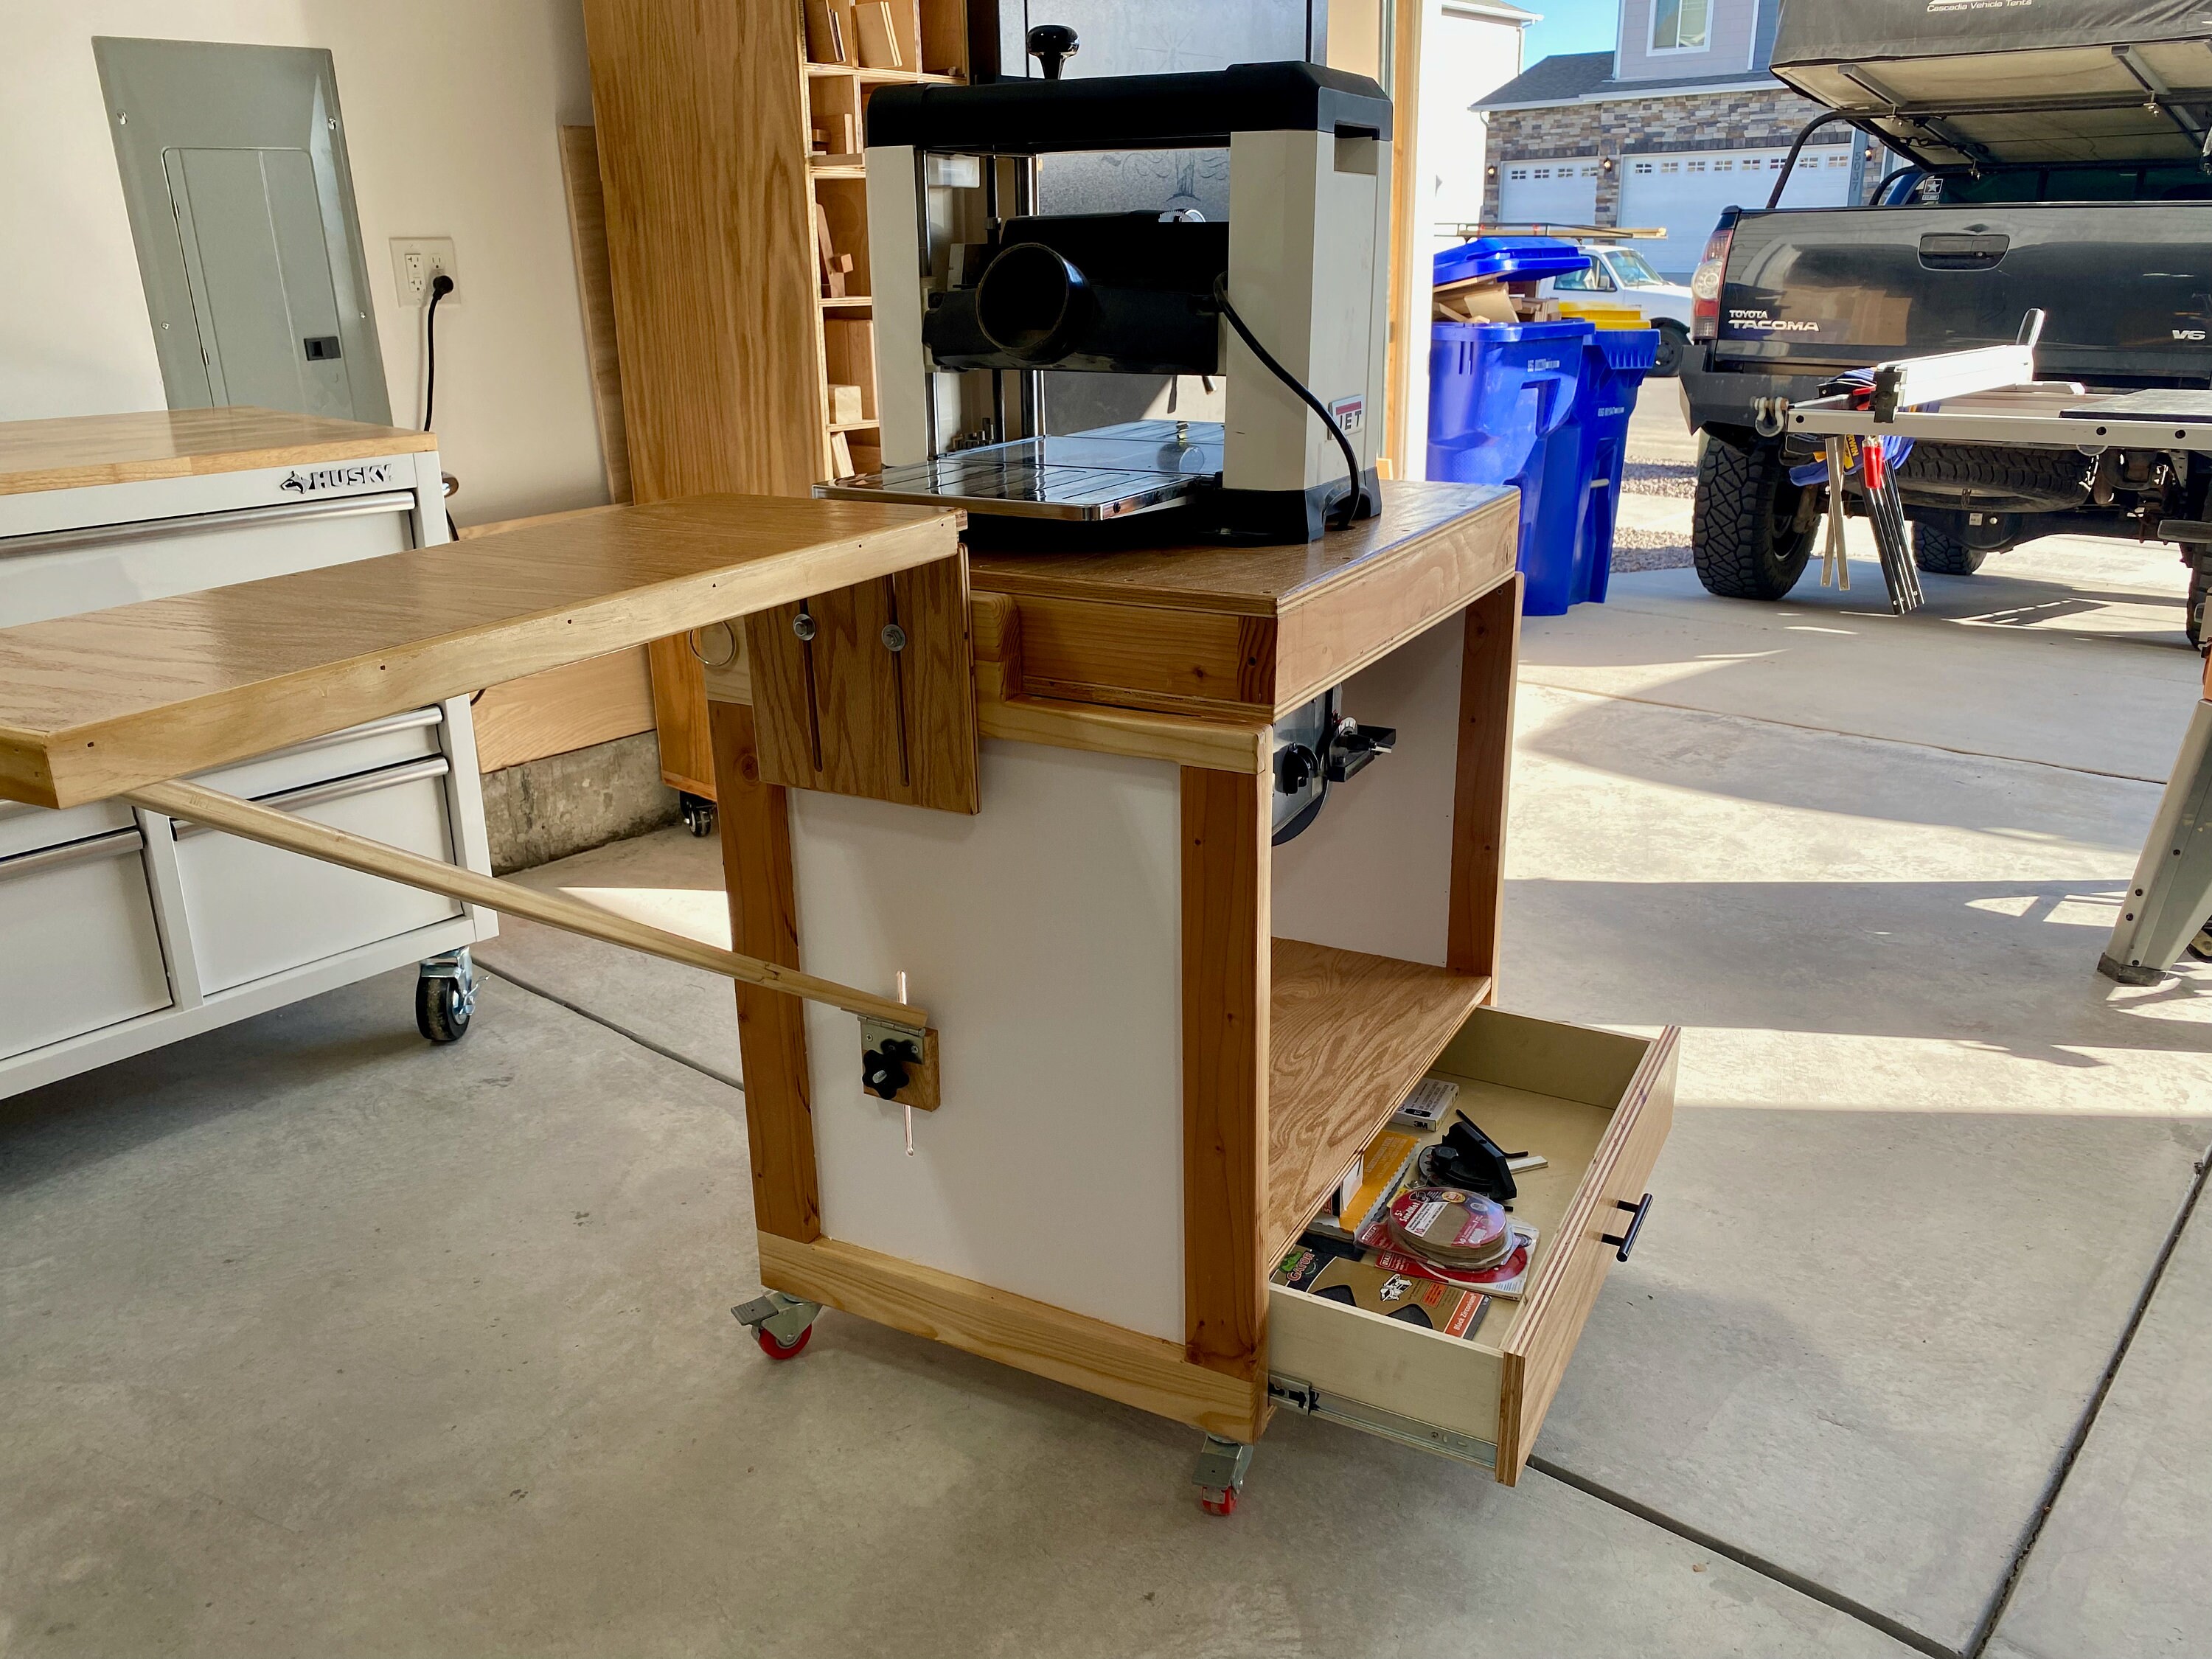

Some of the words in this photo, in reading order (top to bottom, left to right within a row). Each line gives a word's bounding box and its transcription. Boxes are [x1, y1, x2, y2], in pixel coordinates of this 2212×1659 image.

[1927, 4, 1968, 13] Cascadia
[1970, 1, 2003, 10] Vehicle
[1728, 310, 1768, 319] TOYOTA
[1728, 319, 1820, 332] TACOMA
[2172, 330, 2206, 341] V6
[1846, 434, 1860, 457] RWIN
[309, 464, 392, 490] HUSKY
[1413, 1120, 1428, 1130] 3M
[1287, 1251, 1315, 1281] GATOR
[1453, 1318, 1465, 1331] Black
